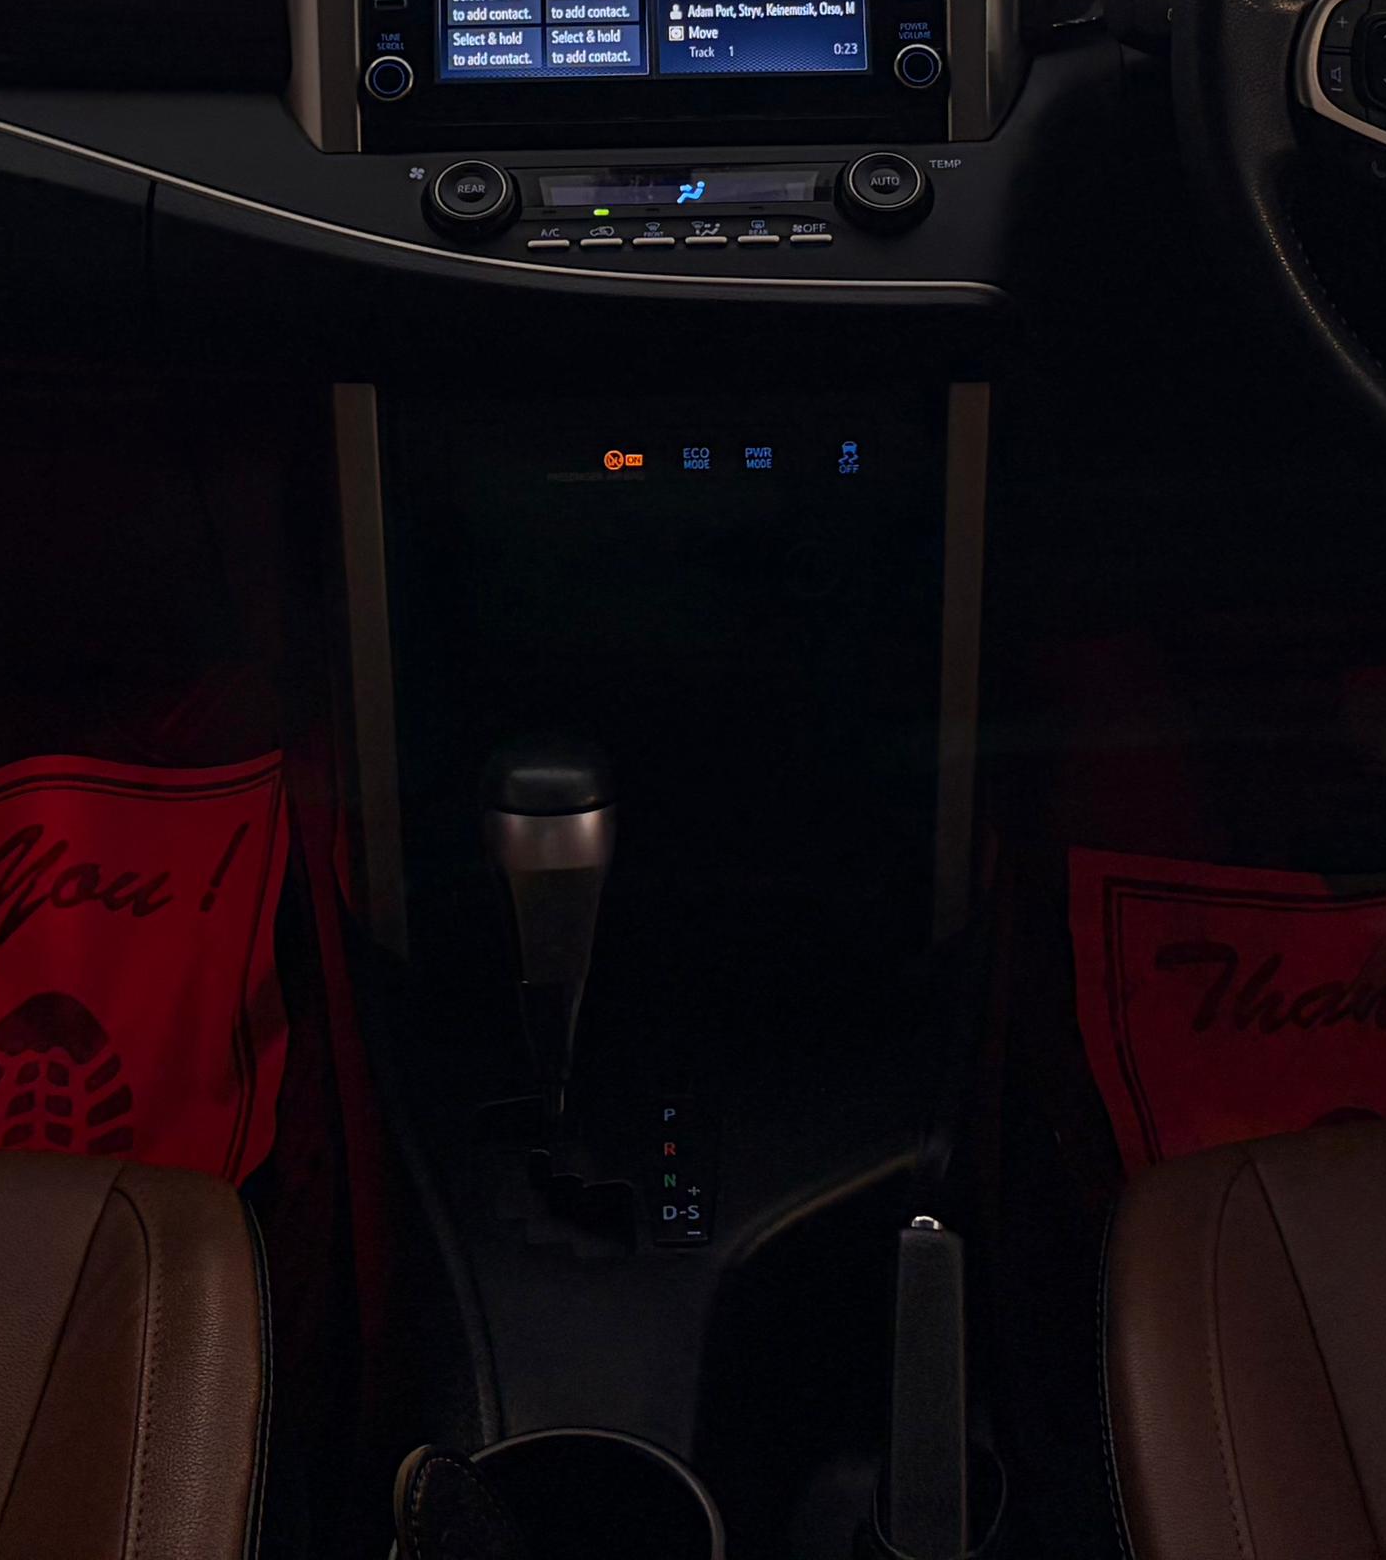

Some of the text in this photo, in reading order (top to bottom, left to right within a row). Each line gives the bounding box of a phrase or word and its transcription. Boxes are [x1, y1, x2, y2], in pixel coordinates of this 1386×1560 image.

[453, 7, 532, 21] to add contact.
[551, 5, 630, 19] to add contact.
[688, 1, 855, 19] Adam Port, Stryv, Keinemusik, Orso, M
[381, 34, 400, 42] TUNE
[551, 29, 621, 44] Select & hold
[688, 26, 718, 39] Move
[899, 31, 931, 40] VOLUME
[453, 32, 523, 46] Select & hold
[689, 43, 858, 58] Track 1 0:23
[453, 52, 532, 66] to add contact.
[552, 50, 631, 64] to add contact.
[929, 158, 962, 169] TEMP
[870, 176, 900, 186] AUTO
[456, 183, 486, 195] REAR
[541, 228, 560, 238] A/C
[803, 223, 827, 233] OFF
[683, 447, 710, 459] ECO
[745, 447, 772, 459] PWR
[626, 456, 642, 466] ON
[684, 459, 710, 469] MODE
[746, 459, 772, 469] MODE
[839, 464, 859, 474] OFF
[663, 1107, 677, 1122] P
[663, 1141, 677, 1158] R
[663, 1173, 677, 1189] N
